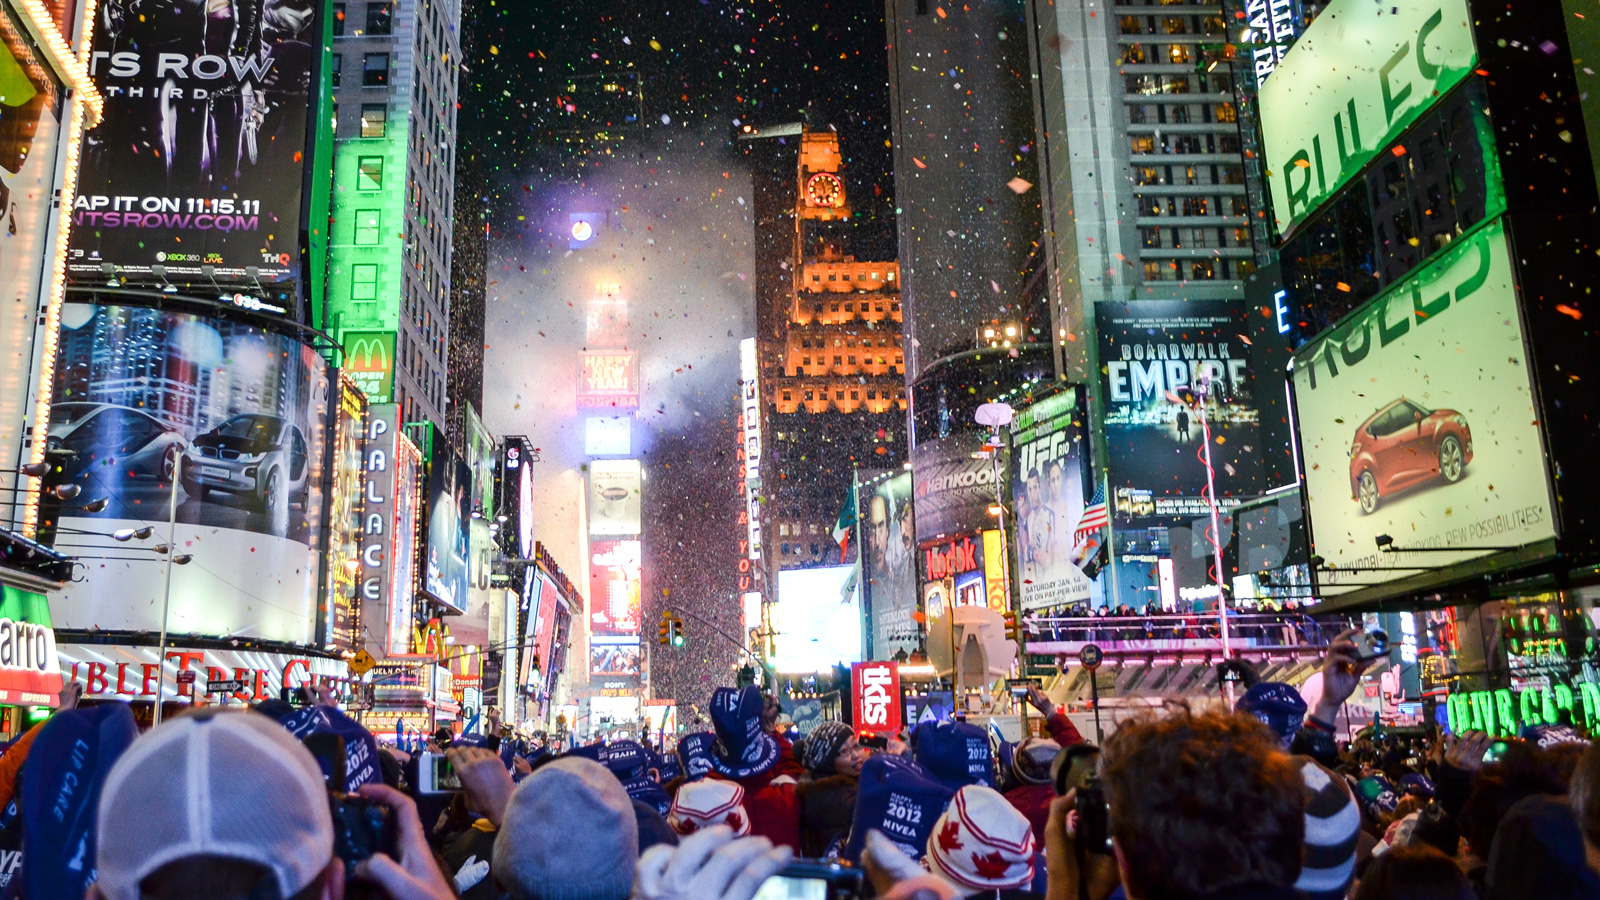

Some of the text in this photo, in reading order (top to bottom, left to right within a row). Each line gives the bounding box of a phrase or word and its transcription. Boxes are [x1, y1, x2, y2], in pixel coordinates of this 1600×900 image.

[157, 53, 275, 82] ROW
[106, 86, 208, 100] THIRD
[114, 197, 138, 211] IT
[142, 197, 180, 212] ON
[183, 199, 260, 215] 11.15.11
[262, 253, 290, 266] THQ
[1121, 343, 1230, 361] BOARDWALK
[585, 355, 632, 367] HAPPY
[351, 371, 385, 380] OPEN
[592, 367, 624, 378] NEW
[578, 396, 639, 407] TOSHIBA
[1020, 430, 1066, 483] UFC
[363, 418, 388, 600] PALACE
[1025, 581, 1056, 594] SATURDAY
[22, 692, 50, 704] ESPRESSO
[863, 665, 892, 725] tkts
[345, 743, 370, 777] 2012
[968, 748, 988, 760] 2012
[53, 738, 90, 823] LIP CARE
[348, 764, 374, 792] NIVEA
[891, 792, 912, 803] HAPPY
[906, 801, 922, 810] YEAR
[886, 803, 922, 823] 2012
[883, 818, 917, 837] NIVEA
